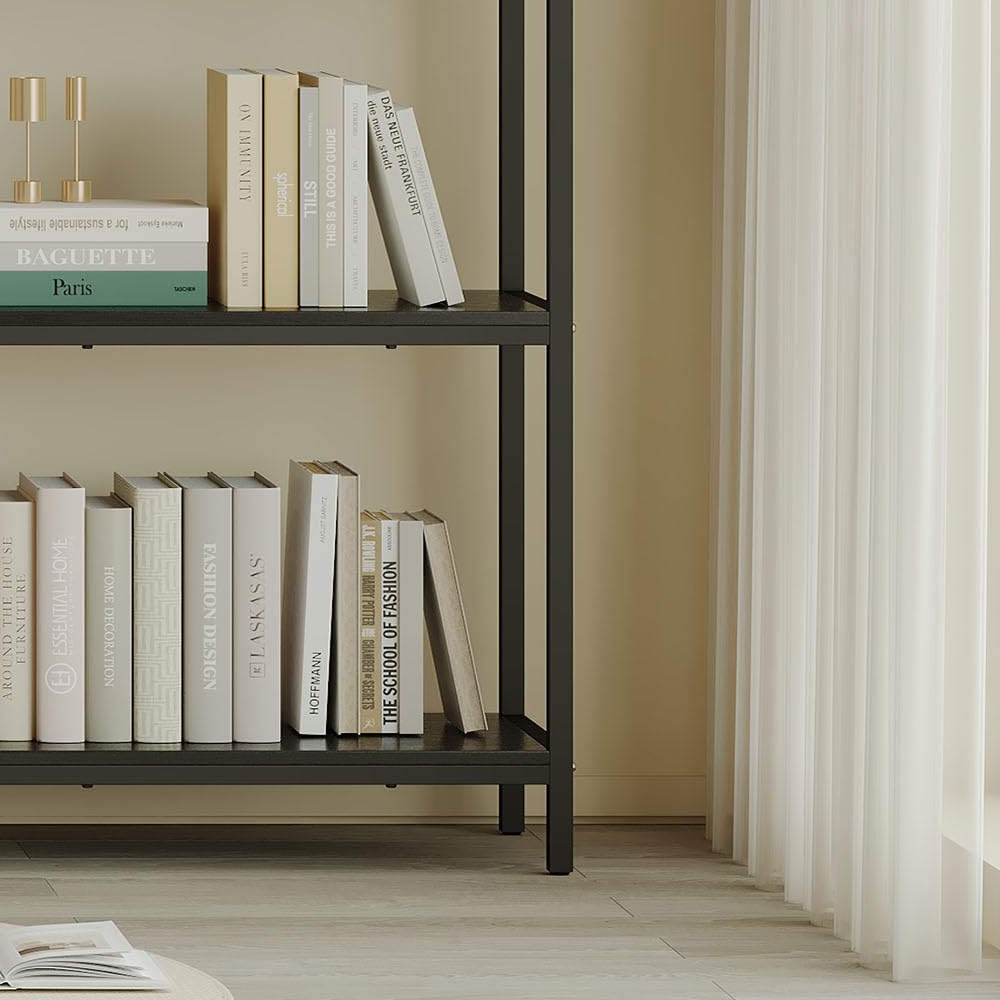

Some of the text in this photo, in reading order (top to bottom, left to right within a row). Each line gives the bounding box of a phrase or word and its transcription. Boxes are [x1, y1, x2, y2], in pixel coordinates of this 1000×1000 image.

[239, 104, 252, 201] ON IMMUNITY
[367, 100, 393, 171] die neue stadt
[381, 96, 422, 217] DAS NEUE FRANKFURT
[272, 170, 294, 217] spherical
[303, 180, 317, 219] STILL
[325, 127, 337, 249] THIS IS A GOOD GUIDE
[9, 215, 47, 231] lifestyle
[49, 216, 104, 231] sustainable
[106, 218, 113, 229] a
[116, 216, 129, 231] for
[16, 247, 156, 266] BAGUETTE
[52, 277, 93, 296] Paris
[362, 524, 376, 539] J.K.
[362, 540, 376, 573] ROWLING
[52, 537, 68, 656] ESSENTIAL HOME
[362, 575, 375, 598] HARRY
[2, 536, 14, 703] AROUND THE HOUSE
[16, 572, 27, 665] FURNITURE
[103, 566, 115, 688] HOME DECORATION
[203, 543, 217, 690] FASHION DESIGN
[362, 599, 375, 626] POTTER
[362, 639, 375, 673] CHAMBER
[383, 561, 398, 725] THE SCHOOL OF FASHION
[309, 650, 322, 714] HOFFMANN
[362, 679, 375, 710] SECRETS
